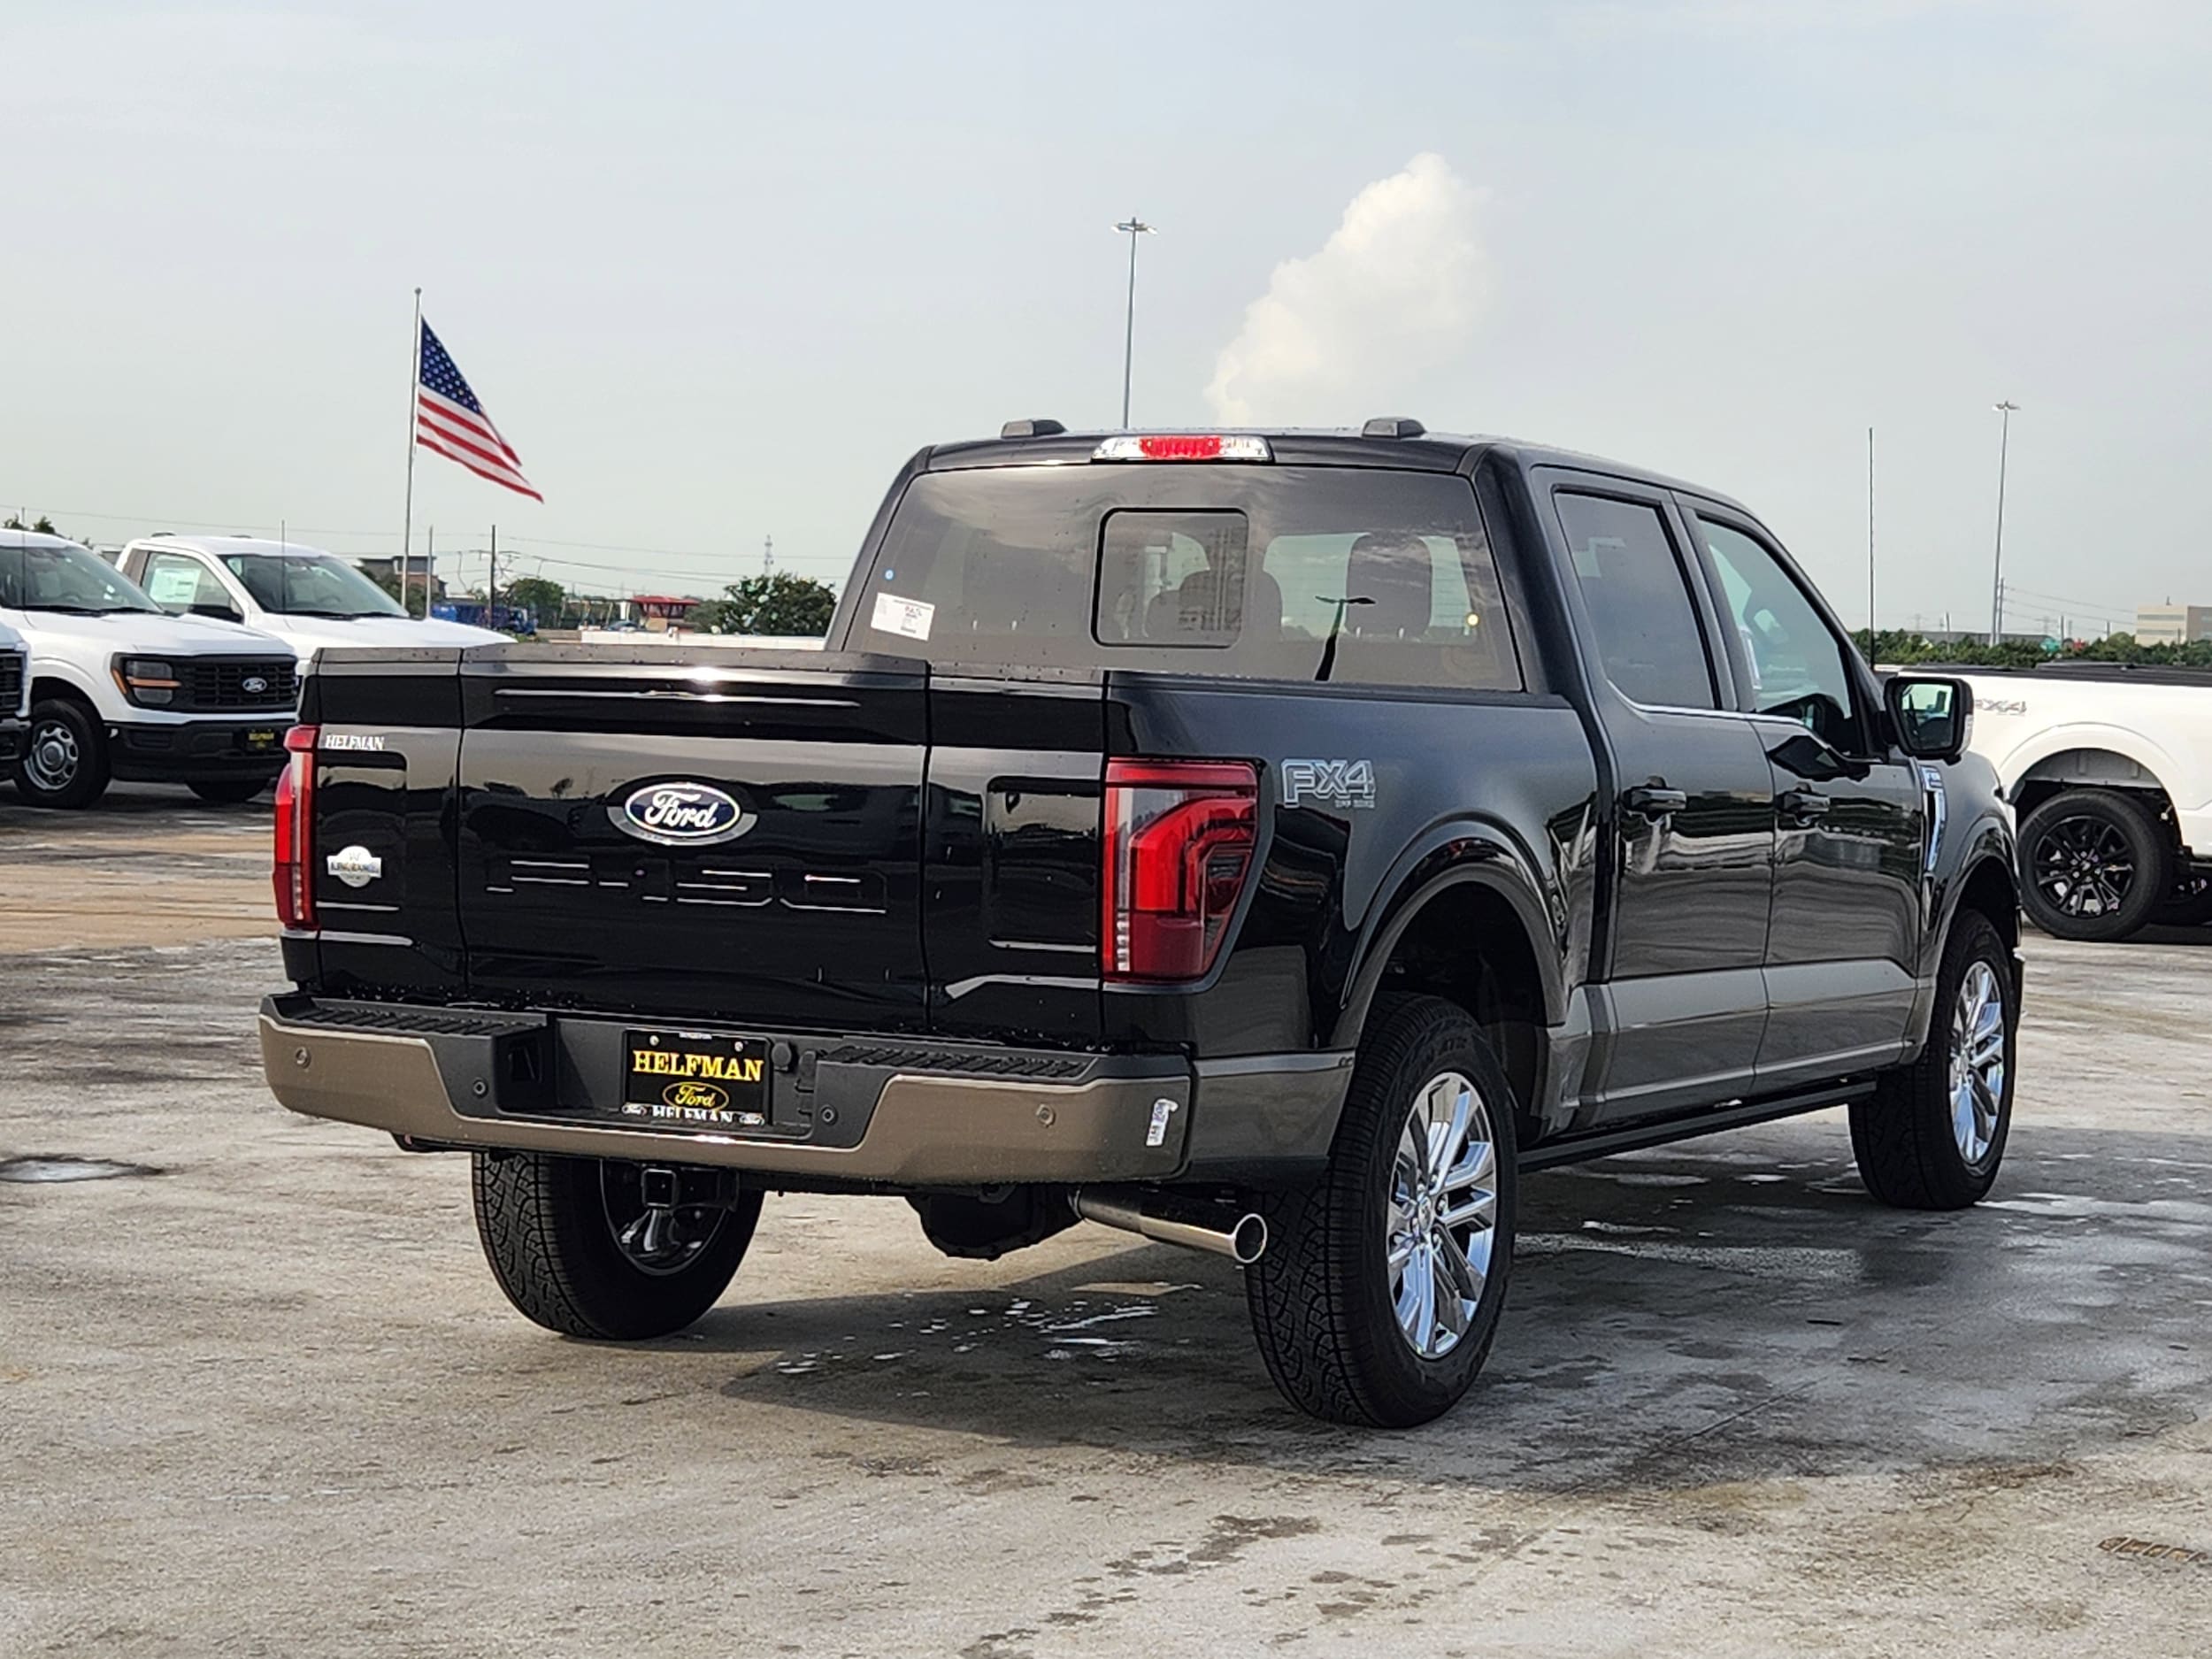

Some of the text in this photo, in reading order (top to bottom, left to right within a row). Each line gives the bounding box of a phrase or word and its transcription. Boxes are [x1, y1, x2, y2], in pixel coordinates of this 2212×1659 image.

[325, 733, 385, 751] HELFMAN
[1281, 758, 1376, 809] FX4
[644, 790, 719, 828] Ford
[632, 1049, 765, 1082] HELFMAN
[674, 1085, 717, 1108] Ford
